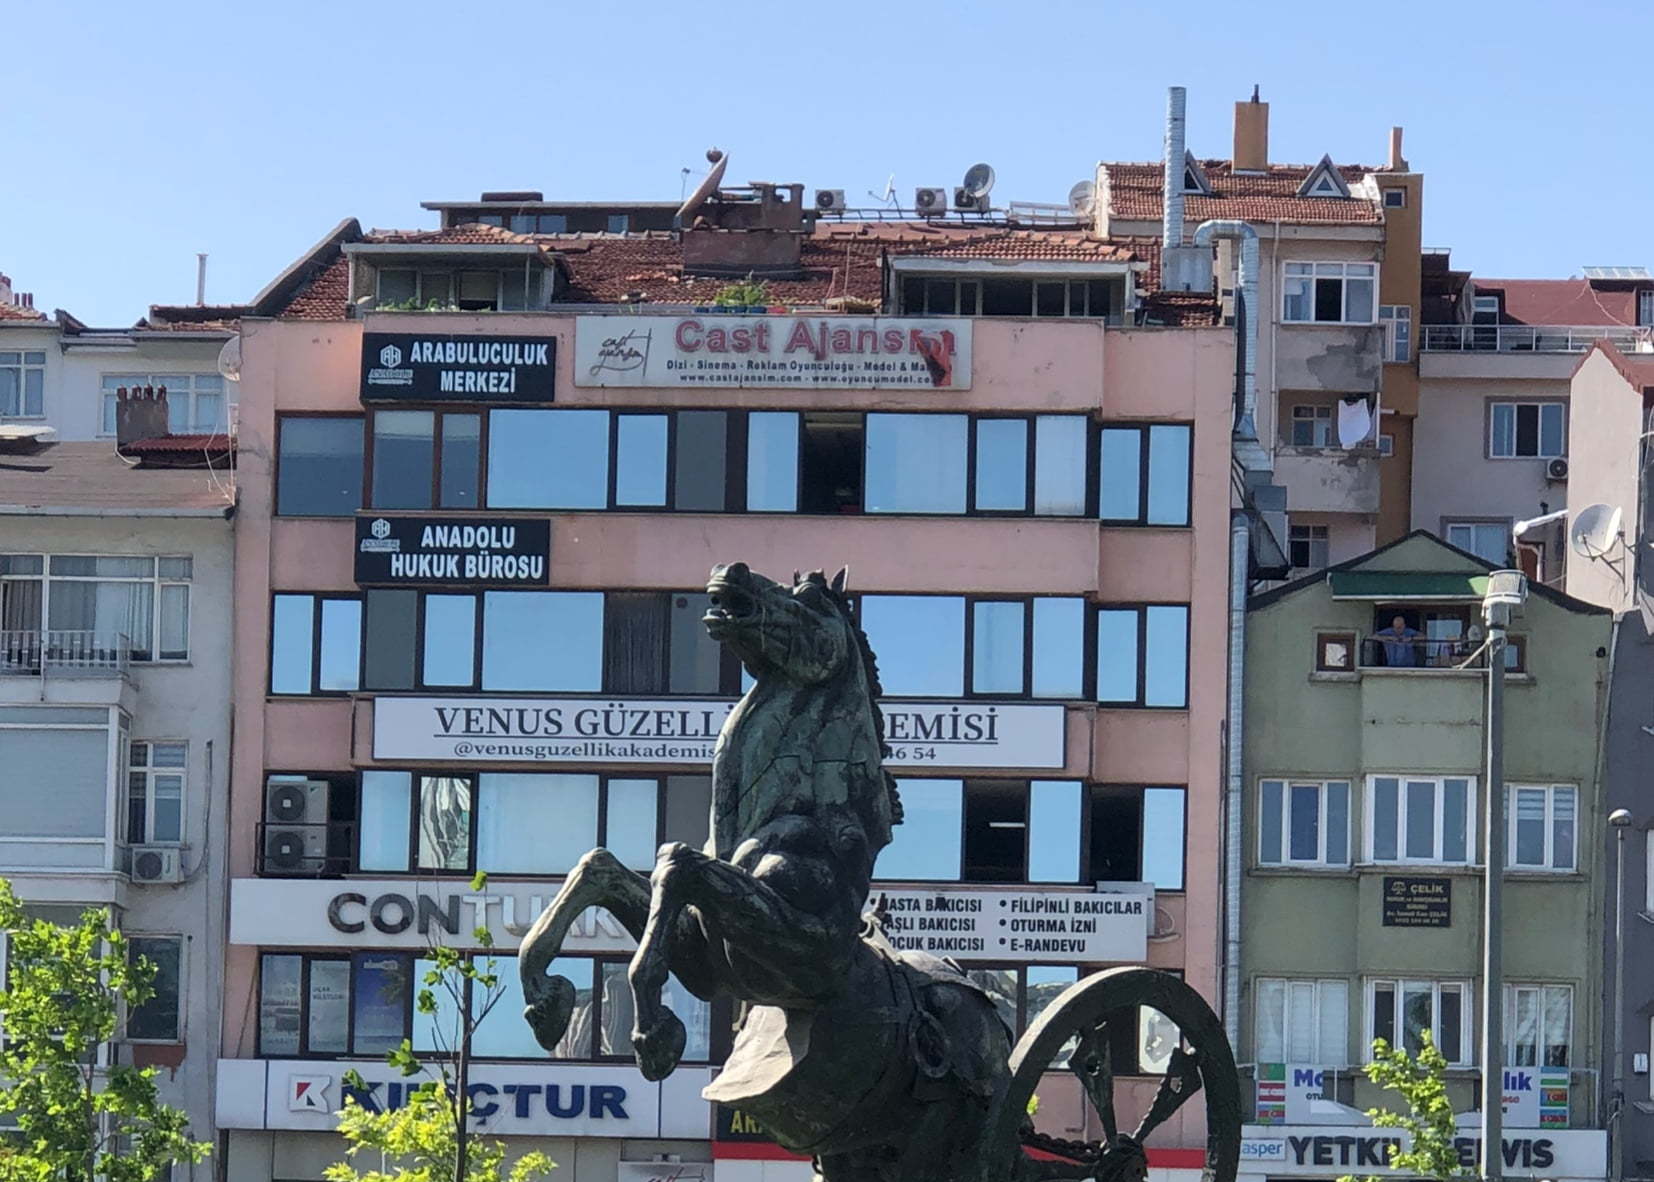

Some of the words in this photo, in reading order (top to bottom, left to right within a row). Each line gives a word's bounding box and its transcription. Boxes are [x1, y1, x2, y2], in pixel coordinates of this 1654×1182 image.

[675, 319, 770, 353] Cast
[410, 341, 548, 365] ARABULUCULUK
[697, 359, 737, 370] Sinema
[747, 359, 787, 371] Reklam
[440, 367, 516, 393] MERKEZİ
[812, 375, 932, 386] www.oyuncumodel.co
[421, 525, 515, 549] ANADOLU
[391, 553, 459, 577] HUKUK
[465, 550, 543, 579] BÜROSU
[433, 707, 563, 735] VENUS
[889, 706, 998, 741] EMİSİ
[912, 747, 937, 760] 54
[925, 897, 982, 912] BAKICISI
[1010, 897, 1070, 914] FİLİPİNLİ
[1074, 899, 1143, 915] BAKICILAR
[327, 892, 625, 938] CONTUK
[886, 916, 914, 933] AŞLI
[919, 917, 975, 931] BAKICISI
[1010, 919, 1067, 934] OTURMA
[1070, 917, 1097, 934] İZNİ
[888, 936, 924, 950] OCUK
[927, 937, 985, 951] BAKICISI
[1010, 937, 1087, 952] E-RANDEVU
[1241, 1143, 1283, 1158] asper
